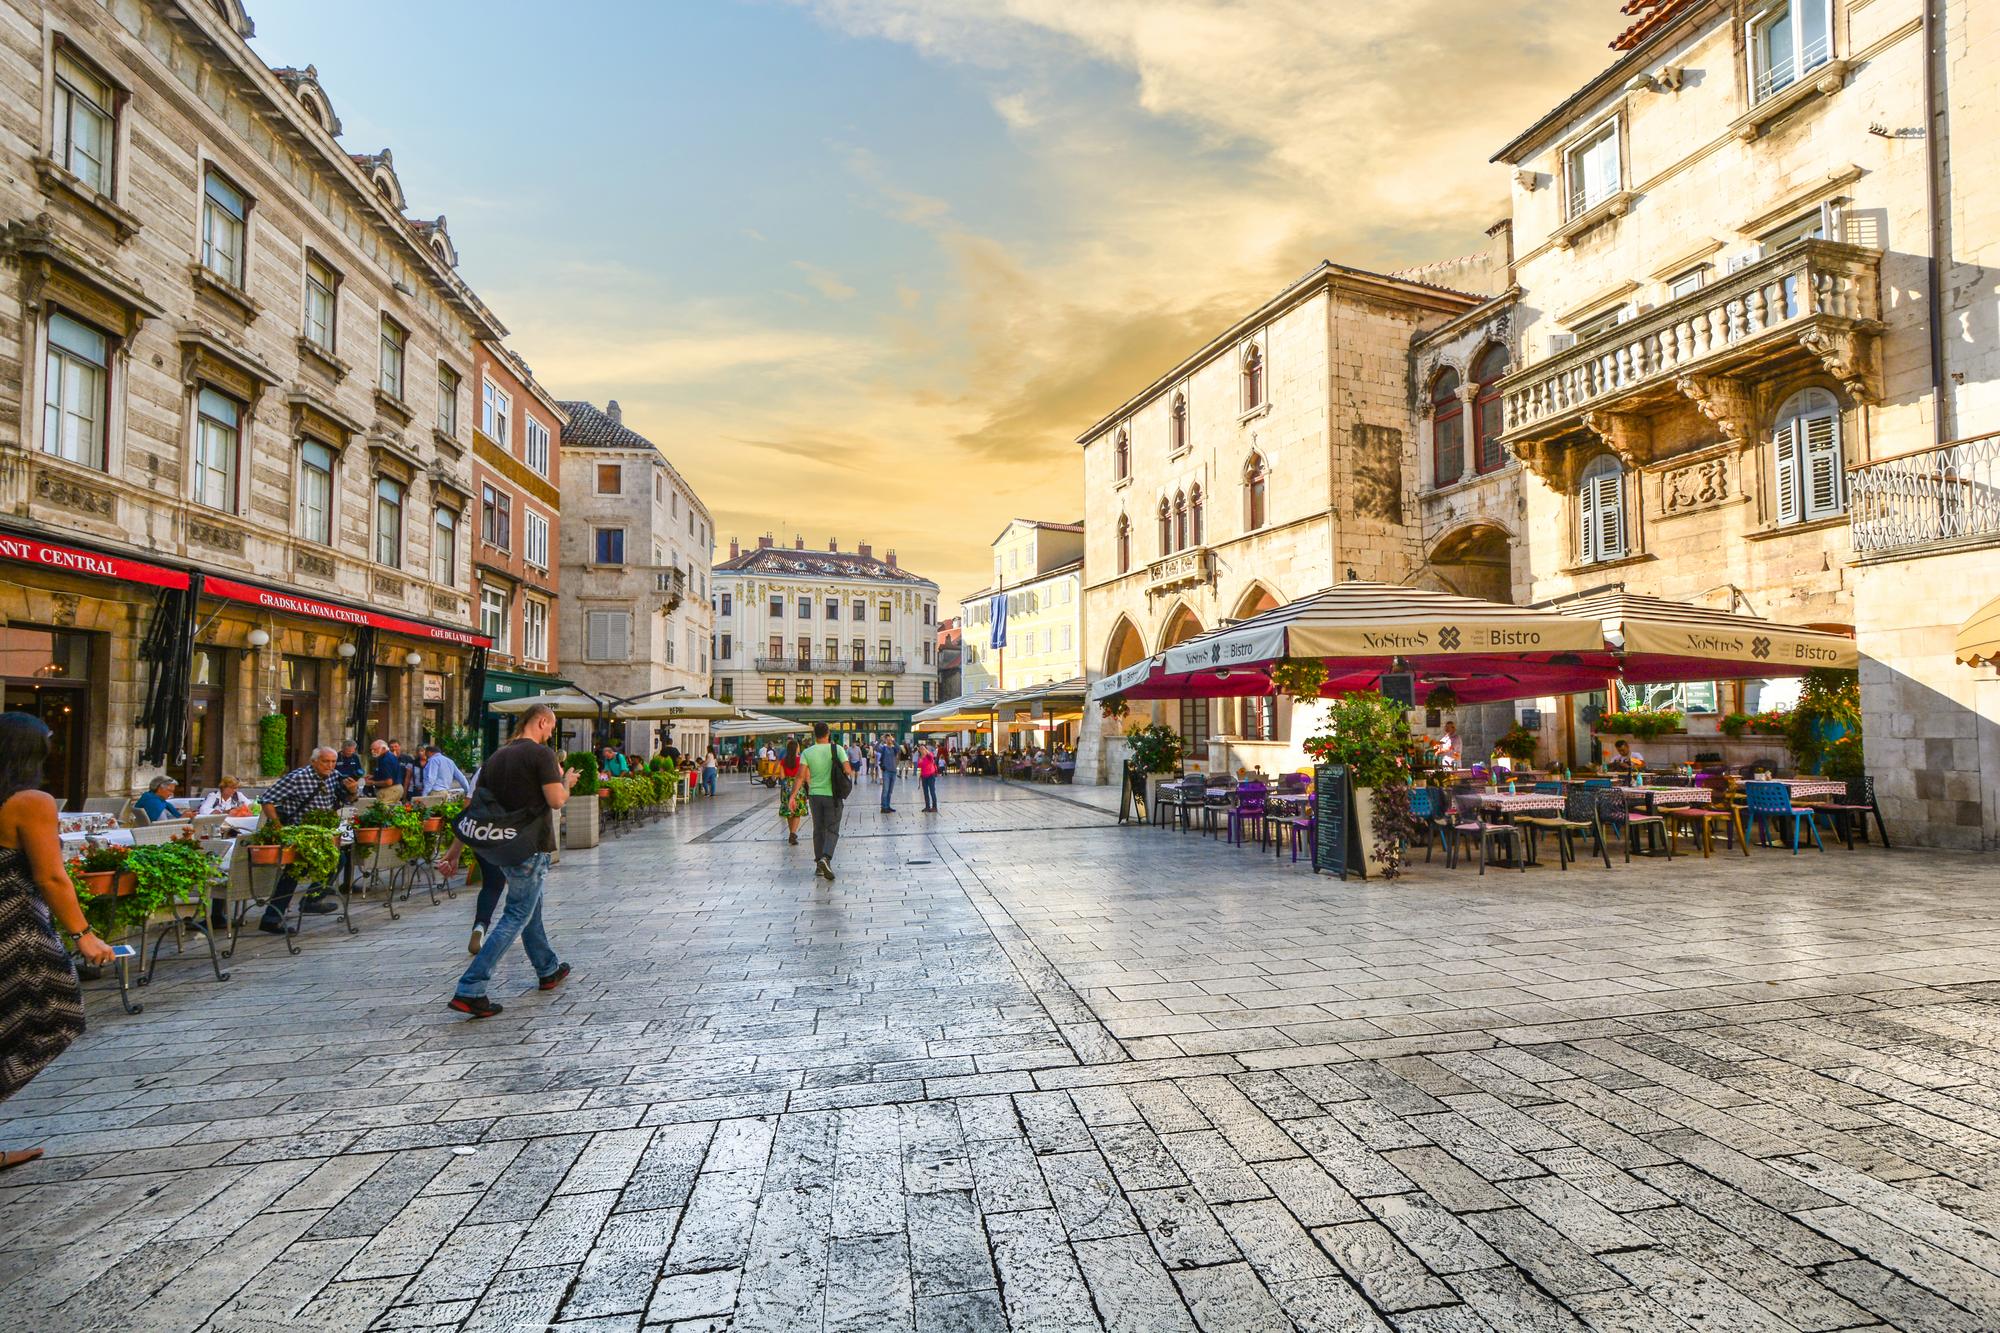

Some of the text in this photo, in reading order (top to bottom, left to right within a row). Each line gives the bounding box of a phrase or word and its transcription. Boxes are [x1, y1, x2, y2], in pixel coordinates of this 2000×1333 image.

[40, 548, 117, 575] CENTRAL
[260, 593, 370, 625] GRADSKA KAVANA CENTRAL
[1490, 629, 1541, 645] Bistro
[1231, 643, 1253, 657] Bistro
[1795, 644, 1837, 661] Bistro
